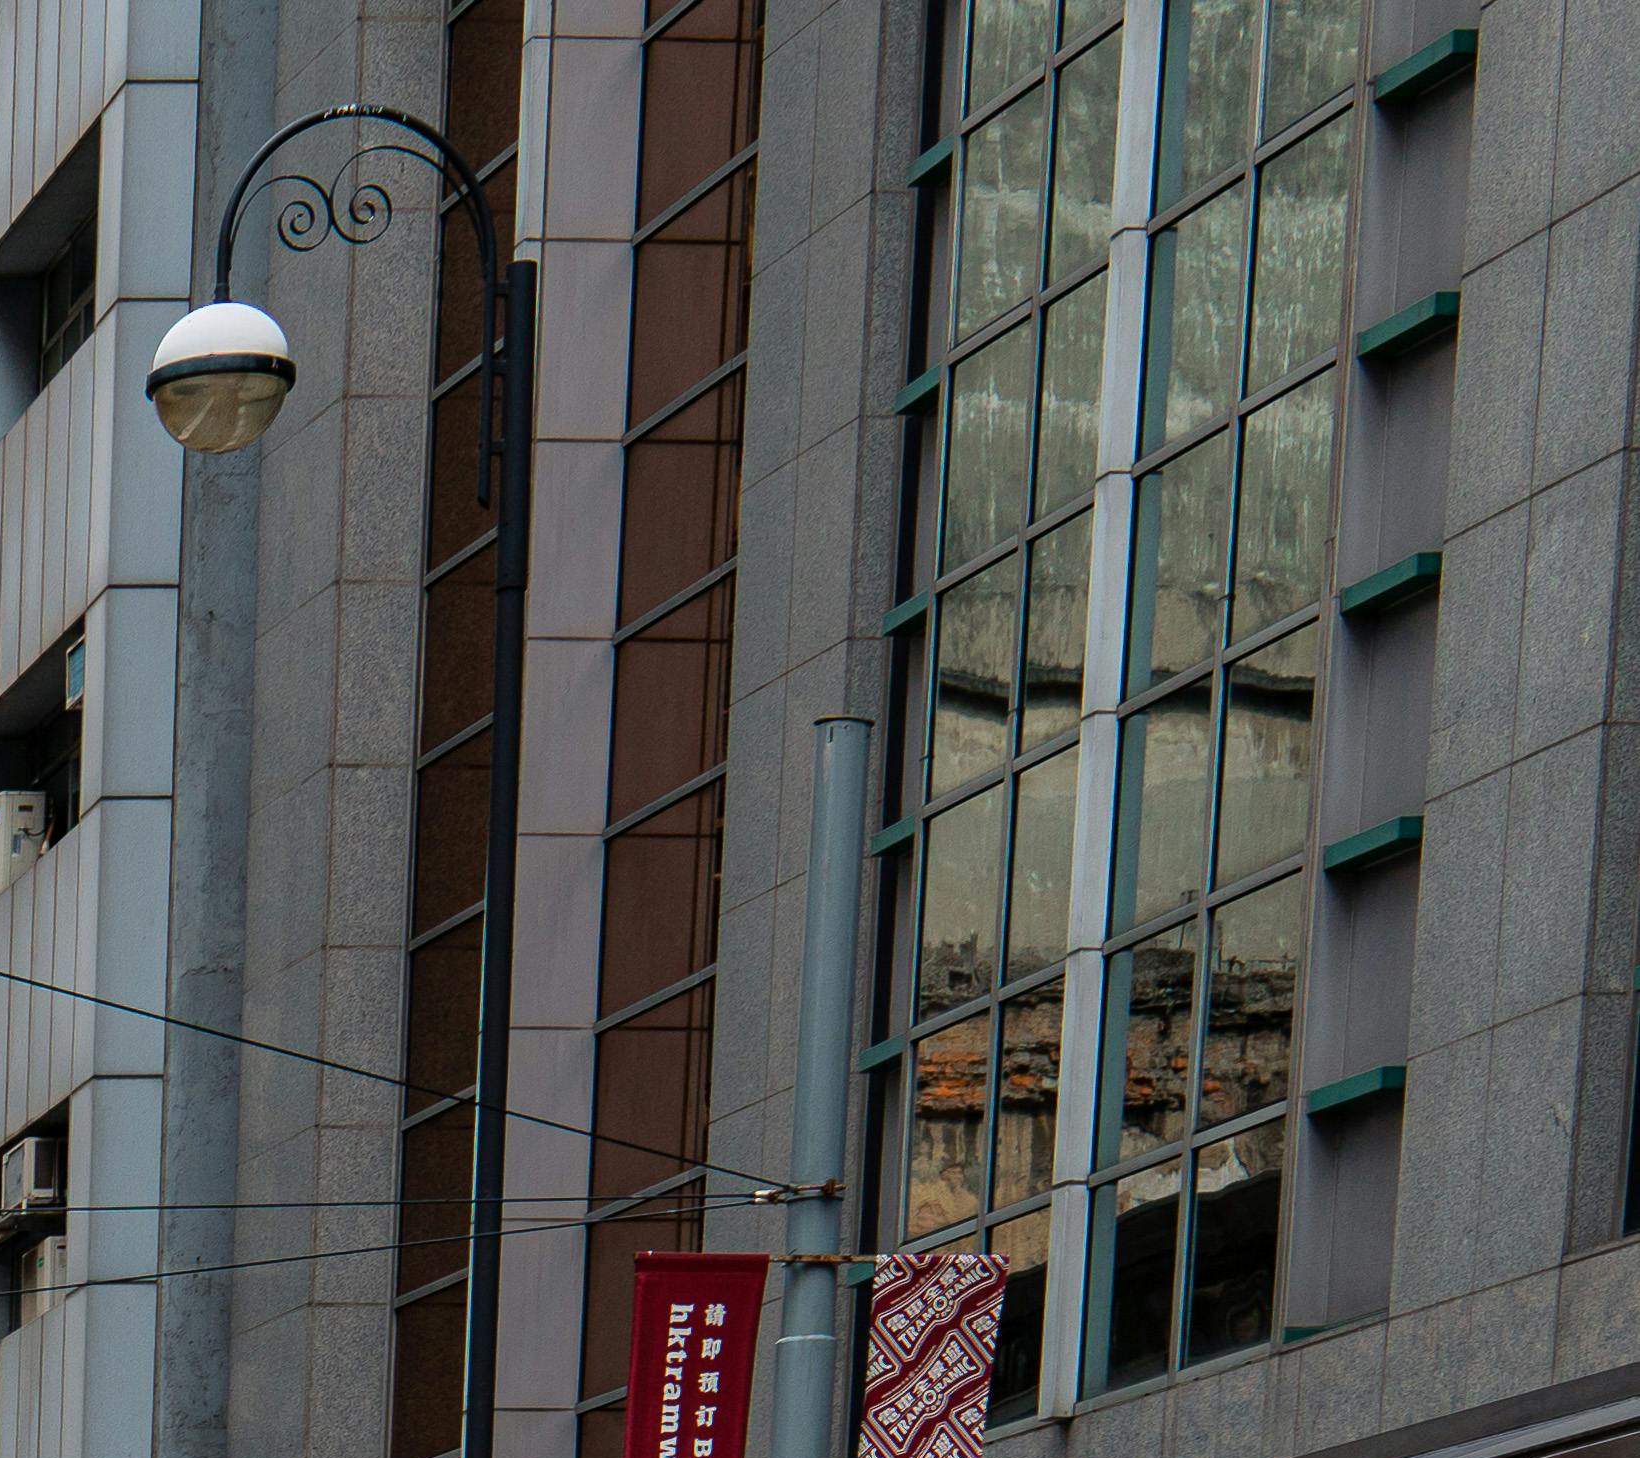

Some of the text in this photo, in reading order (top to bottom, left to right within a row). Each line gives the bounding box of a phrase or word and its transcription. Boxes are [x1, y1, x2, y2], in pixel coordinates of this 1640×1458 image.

[898, 1263, 989, 1348] TRAMORAMIC
[695, 1303, 727, 1427] 請即預訂
[889, 1356, 976, 1443] TRAMORAMIC
